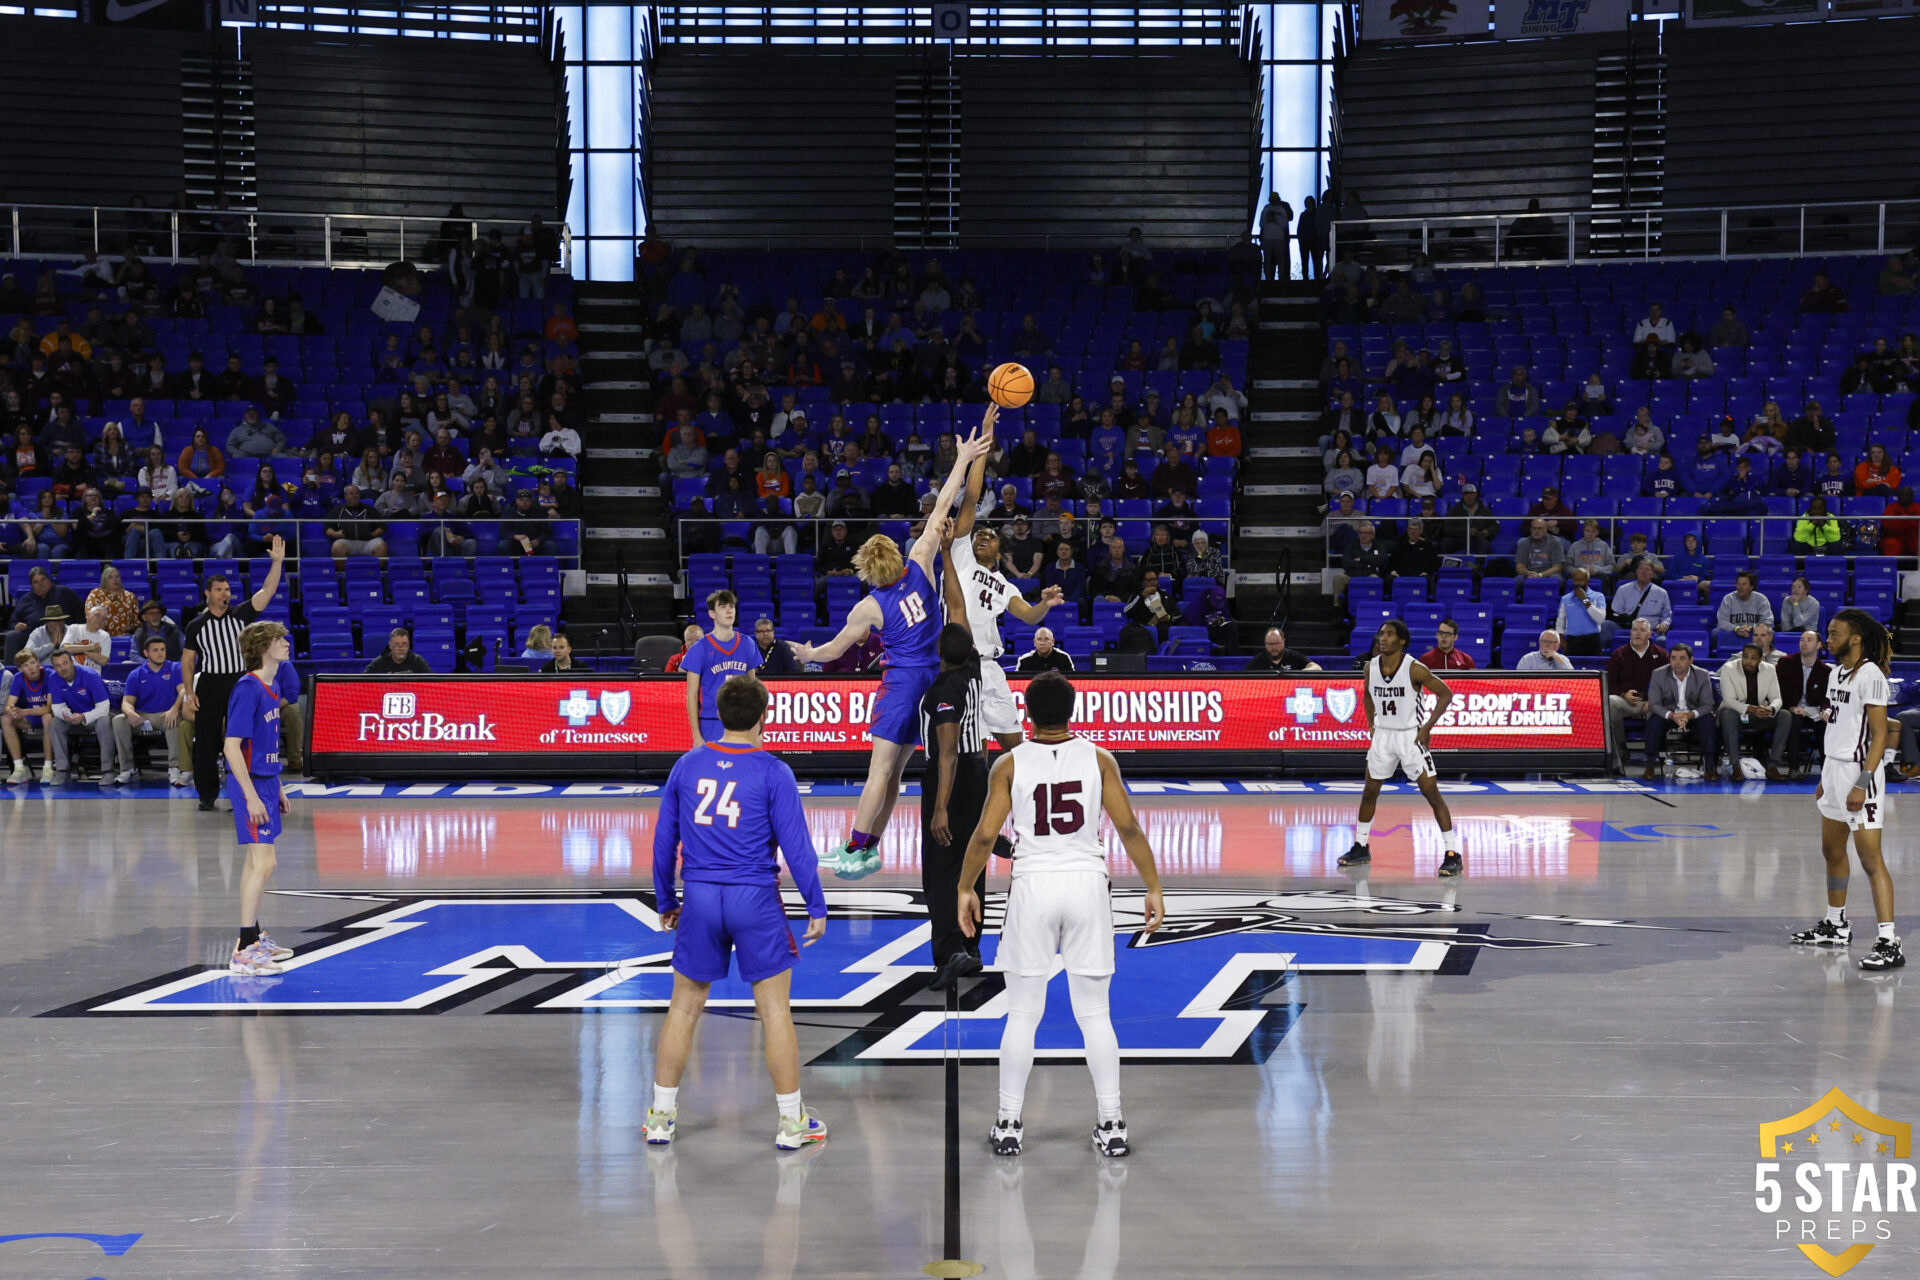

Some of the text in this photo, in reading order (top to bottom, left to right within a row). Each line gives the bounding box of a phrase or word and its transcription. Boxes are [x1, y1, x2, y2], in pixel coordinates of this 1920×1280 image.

[1521, 23, 1557, 33] DINING
[972, 570, 1006, 595] FULTON
[979, 589, 993, 611] 44
[1730, 613, 1761, 624] FULTON
[710, 660, 747, 675] VOLUNTEER
[1374, 686, 1405, 697] FULTON
[387, 697, 411, 714] FB
[1012, 690, 1223, 723] CMPIONSHIPS
[1382, 700, 1397, 716] 14
[1534, 693, 1572, 711] LET
[1458, 711, 1509, 726] DRIVE
[1510, 710, 1573, 726] DRUNK
[357, 713, 497, 741] FirstBank
[1268, 727, 1288, 741] of
[539, 728, 648, 743] of Tennessee
[762, 731, 801, 743] STATE
[803, 731, 847, 743] FINALS
[1108, 729, 1146, 742] STATE
[1149, 729, 1221, 742] UNIVERSITY
[283, 784, 814, 797] MIDD
[694, 777, 742, 829] 24
[1033, 780, 1085, 836] 15
[1864, 803, 1878, 823] F
